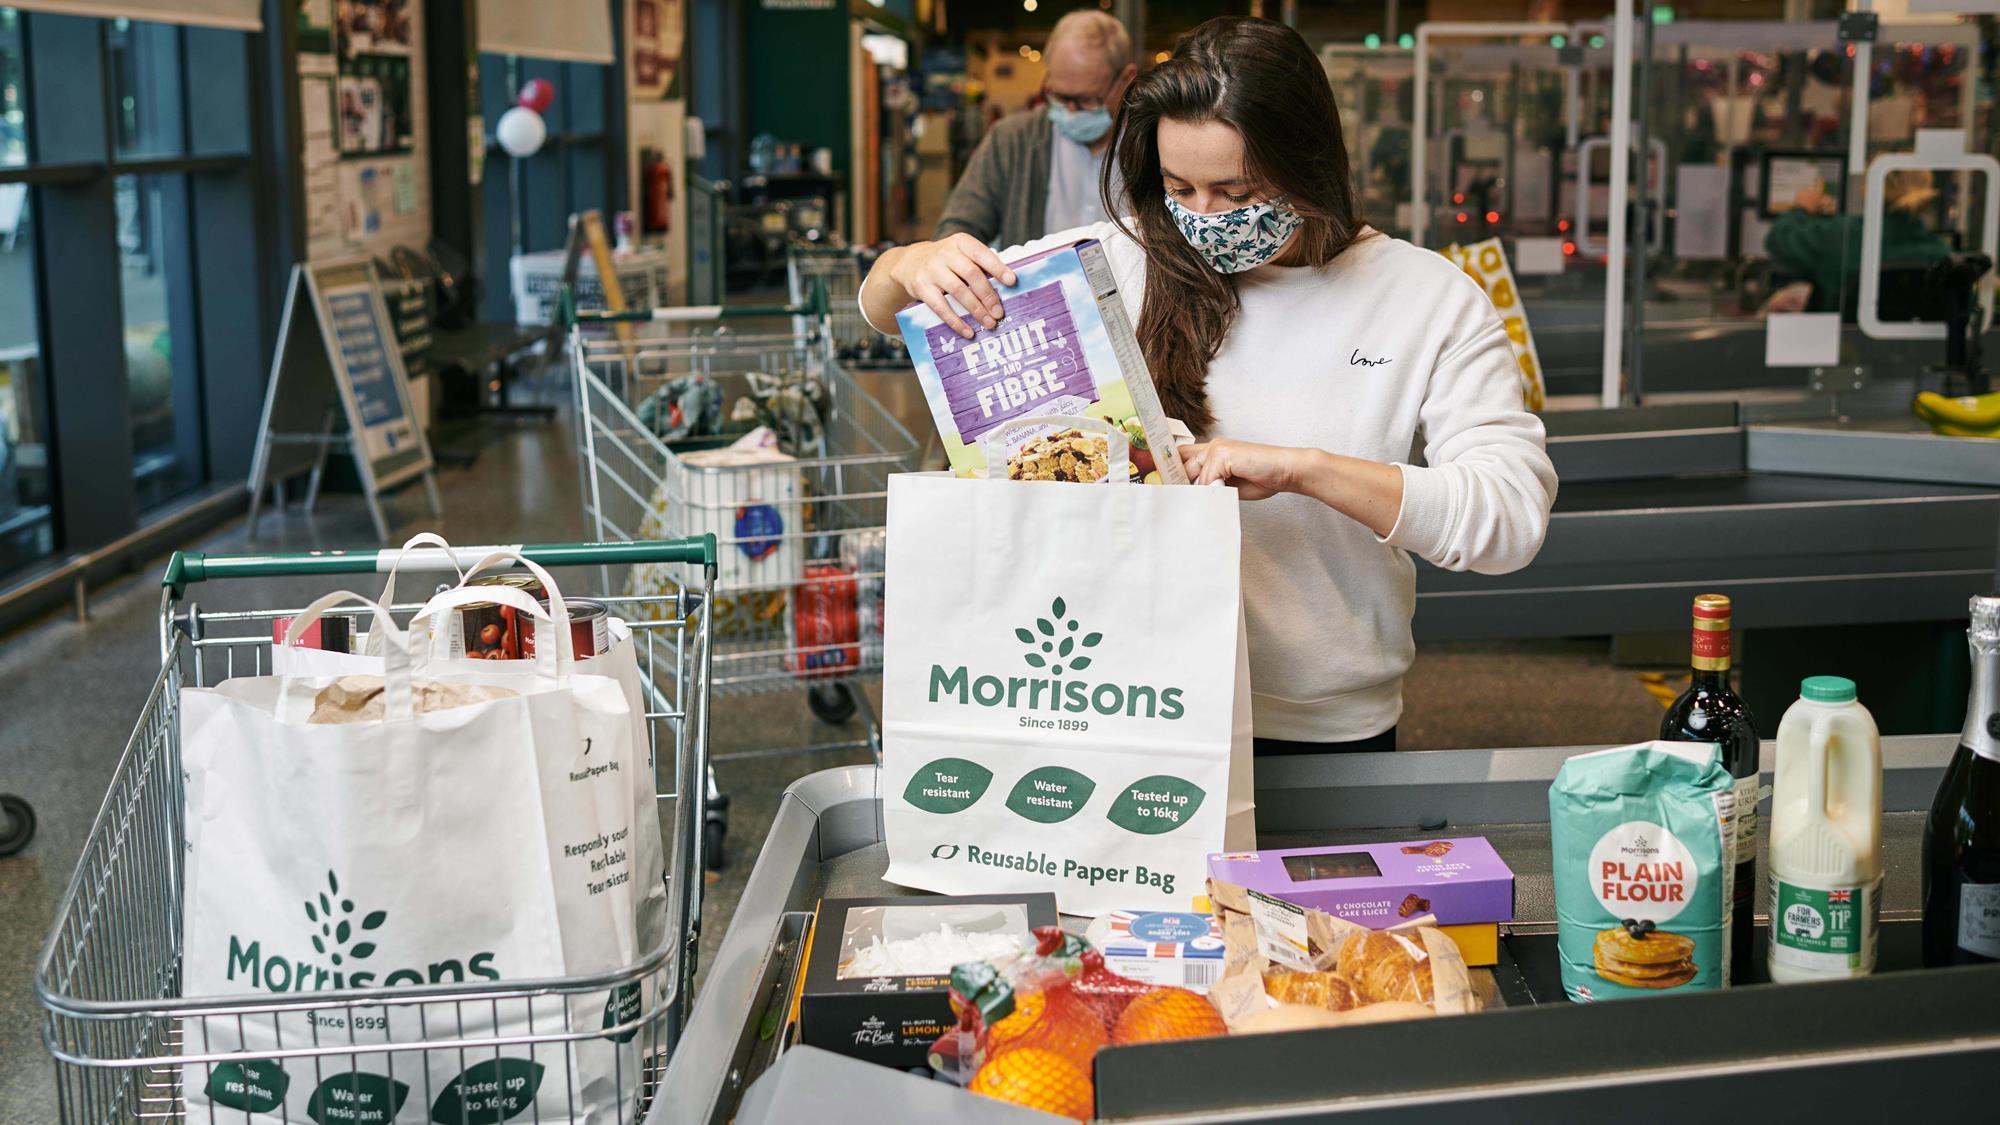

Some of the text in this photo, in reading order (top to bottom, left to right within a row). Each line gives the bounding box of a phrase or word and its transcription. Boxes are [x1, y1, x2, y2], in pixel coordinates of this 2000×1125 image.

[962, 318, 1050, 376] FRUIT
[1003, 361, 1022, 376] AND
[976, 361, 1066, 418] FIBRE
[928, 664, 1185, 720] Morrisons
[1019, 716, 1089, 732] Since 1899
[934, 772, 959, 783] Tear
[922, 787, 970, 799] resistant
[1033, 780, 1068, 794] Water
[1026, 795, 1073, 809] resistant
[1131, 789, 1188, 806] Tested up
[1137, 805, 1179, 822] to 16kg
[967, 845, 1175, 895] Reusable Paper Bag
[1602, 861, 1683, 882] PLAIN
[1603, 882, 1684, 902] FLOUR
[1343, 901, 1391, 909] CHOCOLATE
[1362, 908, 1388, 916] SLICES
[1797, 906, 1811, 916] FOR
[1787, 912, 1821, 926] FARMERS
[351, 1015, 388, 1030] 899
[902, 1026, 940, 1035] LEMON
[225, 1081, 273, 1100] resstant
[506, 1077, 526, 1091] up
[332, 1088, 374, 1103] Waer
[466, 1100, 482, 1111] to
[326, 1106, 384, 1121] resisant
